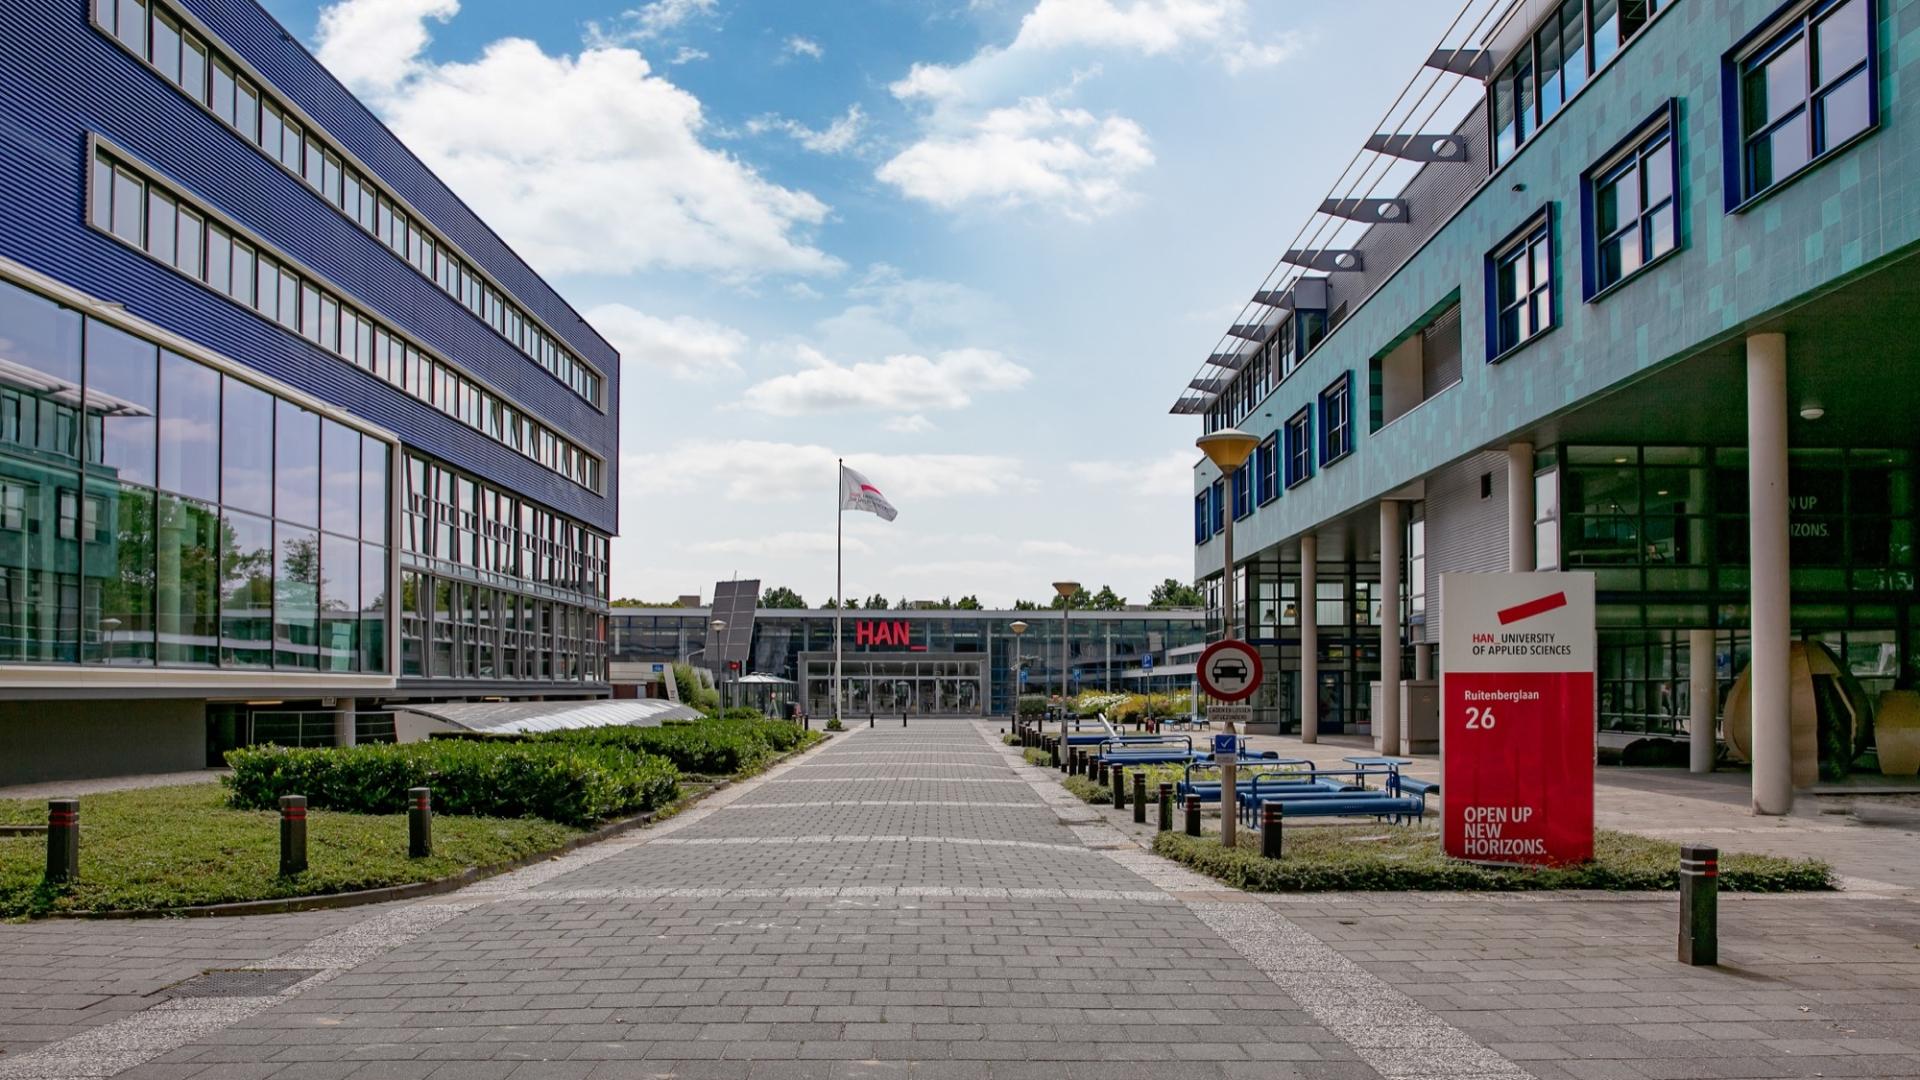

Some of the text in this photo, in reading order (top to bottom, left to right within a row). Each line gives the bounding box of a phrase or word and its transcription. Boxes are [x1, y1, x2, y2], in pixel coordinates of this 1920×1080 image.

[1799, 496, 1818, 510] UP
[1790, 523, 1831, 537] IZONS.
[1472, 645, 1571, 655] OF APPLIED SCIENCES
[1464, 690, 1540, 702] Ruitenberglaan
[1465, 706, 1496, 729] 26
[1464, 807, 1533, 823] OPEN UP
[1464, 823, 1502, 839] NEW
[1464, 839, 1547, 855] HORIZONS.
